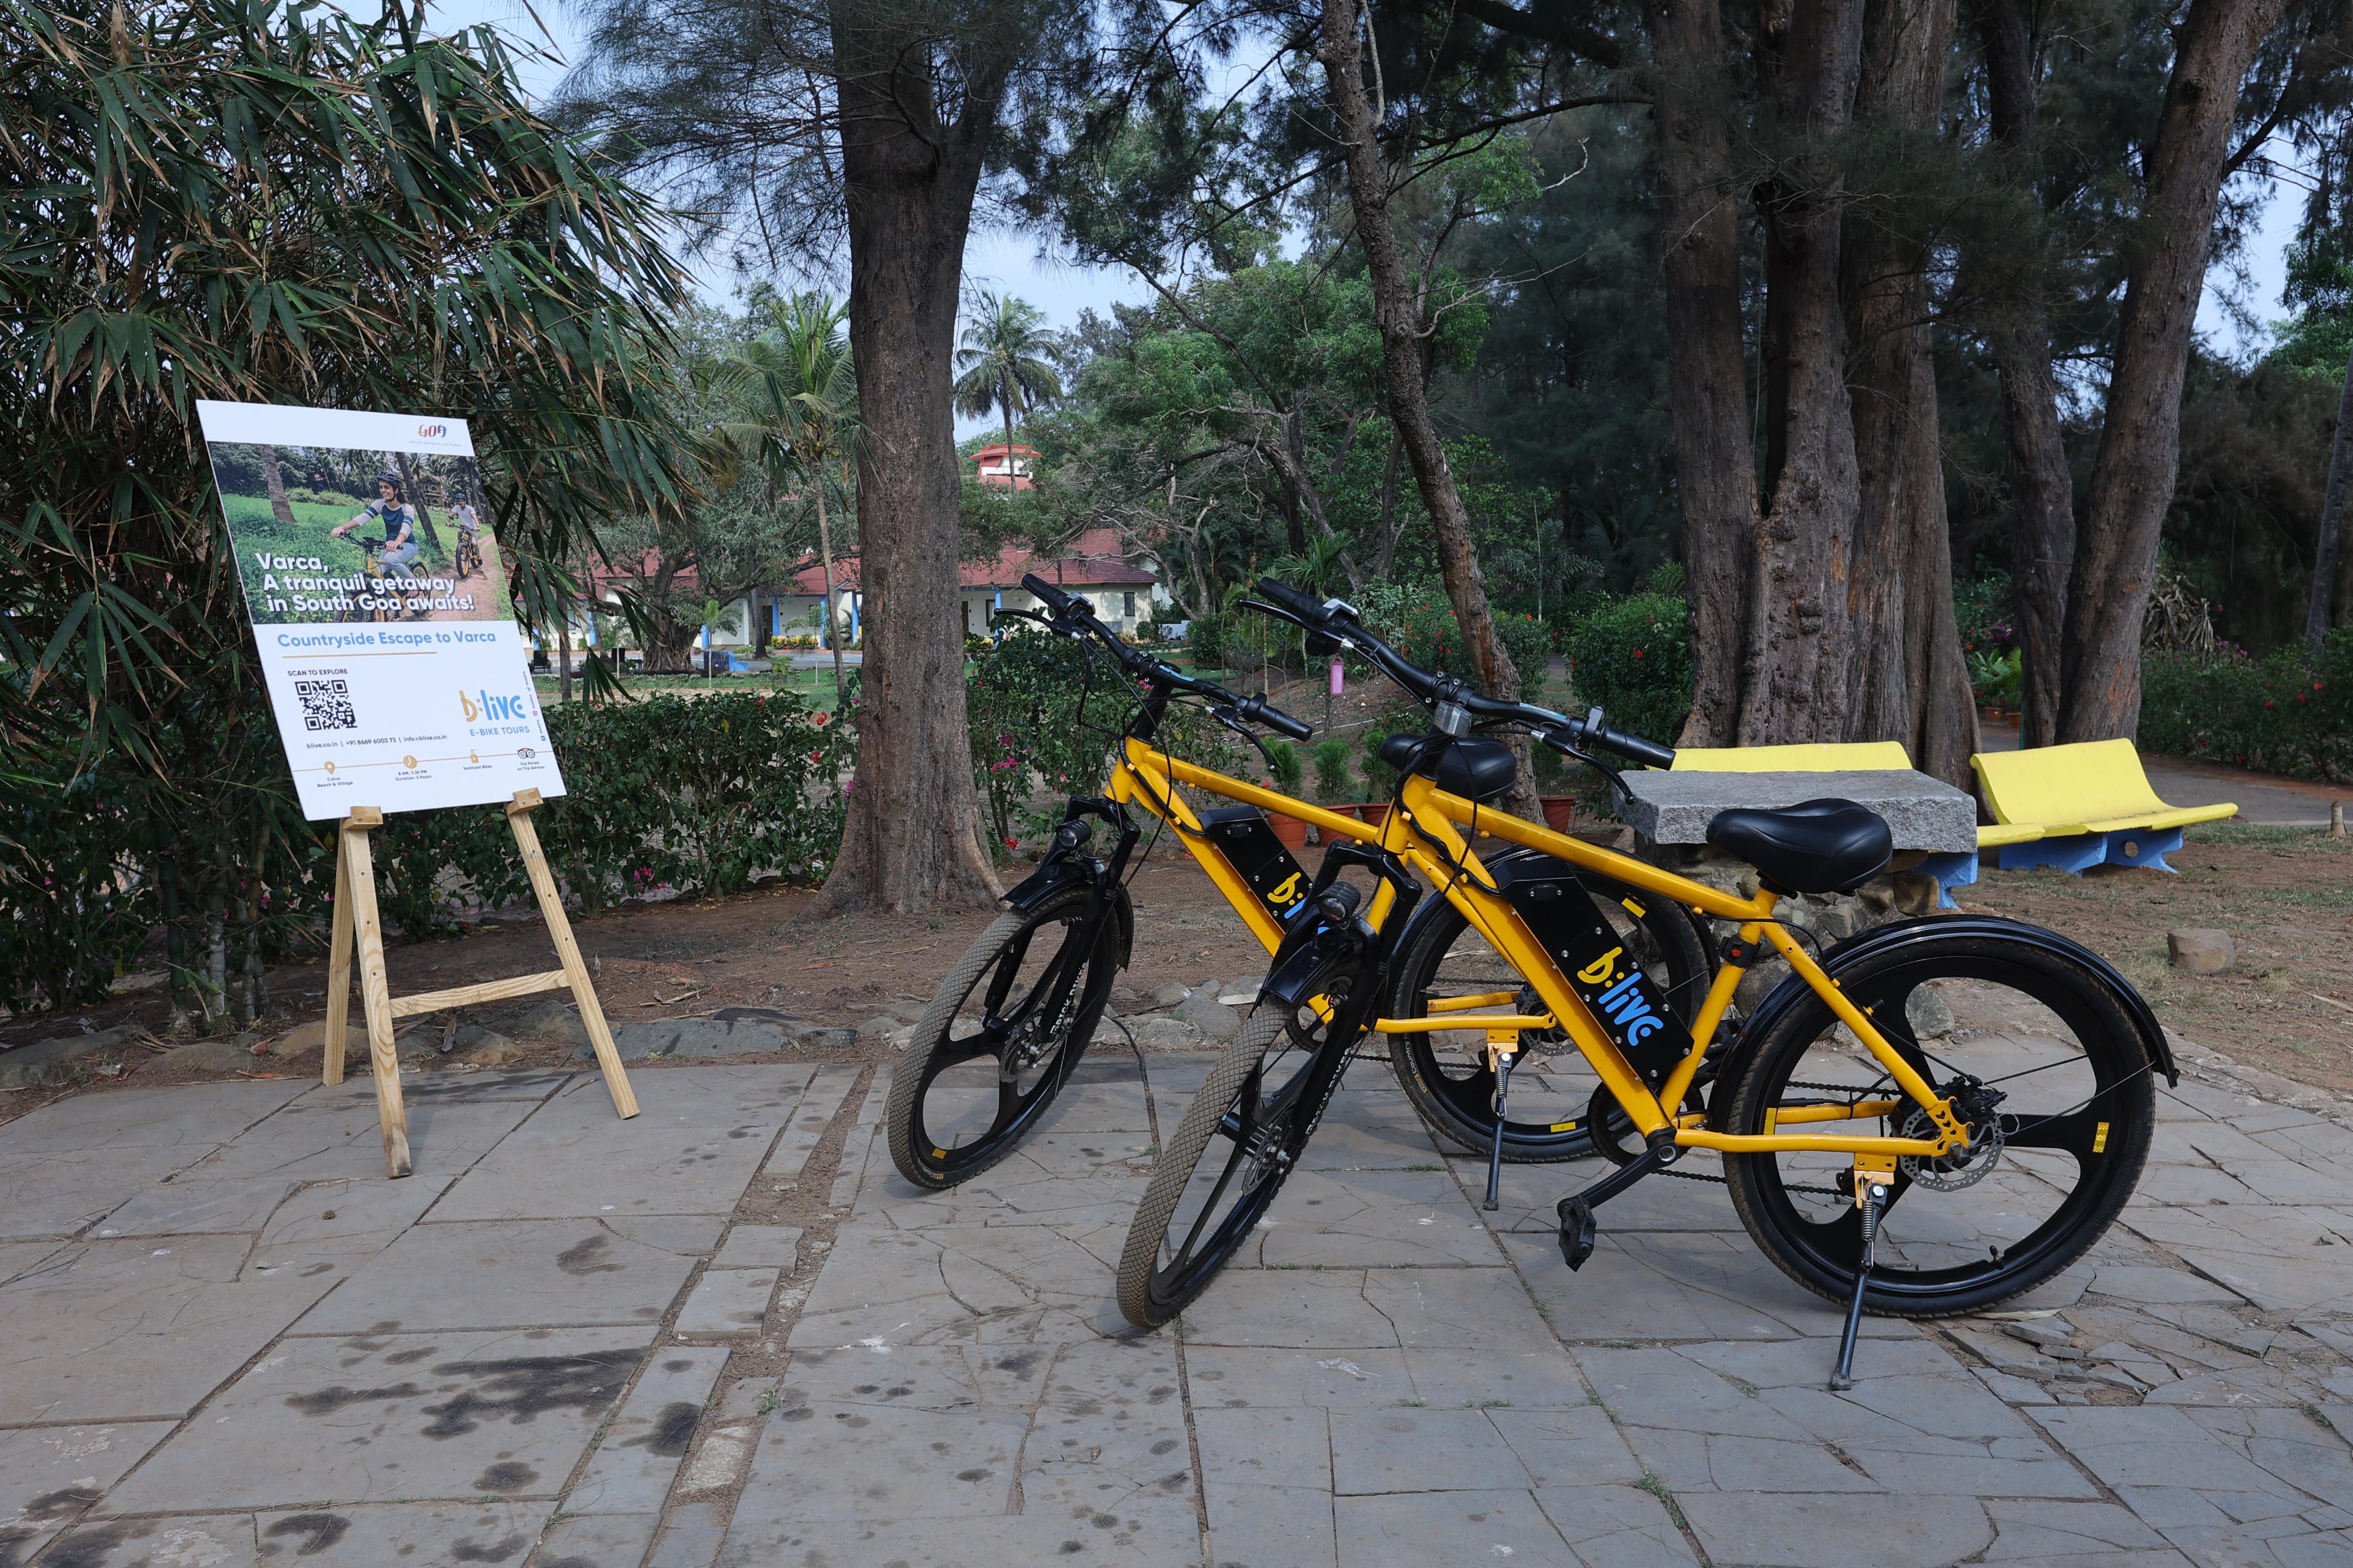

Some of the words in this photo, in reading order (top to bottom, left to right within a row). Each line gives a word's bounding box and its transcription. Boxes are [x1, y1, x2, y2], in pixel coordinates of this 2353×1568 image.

[417, 424, 447, 438] GOA
[255, 553, 329, 573] Varca,
[264, 574, 280, 590] A
[283, 573, 367, 595] tranquil
[371, 576, 455, 595] getaway
[266, 595, 288, 611] in
[292, 593, 354, 611] South
[359, 594, 402, 610] Goa
[406, 593, 475, 610] awaits!
[278, 632, 375, 649] Countryside
[378, 632, 432, 647] Escape
[435, 632, 451, 643] to
[453, 630, 496, 643] Varca
[469, 728, 499, 736] E-BIKE
[501, 726, 530, 735] TOURS
[1405, 1041, 1417, 1074] Country
